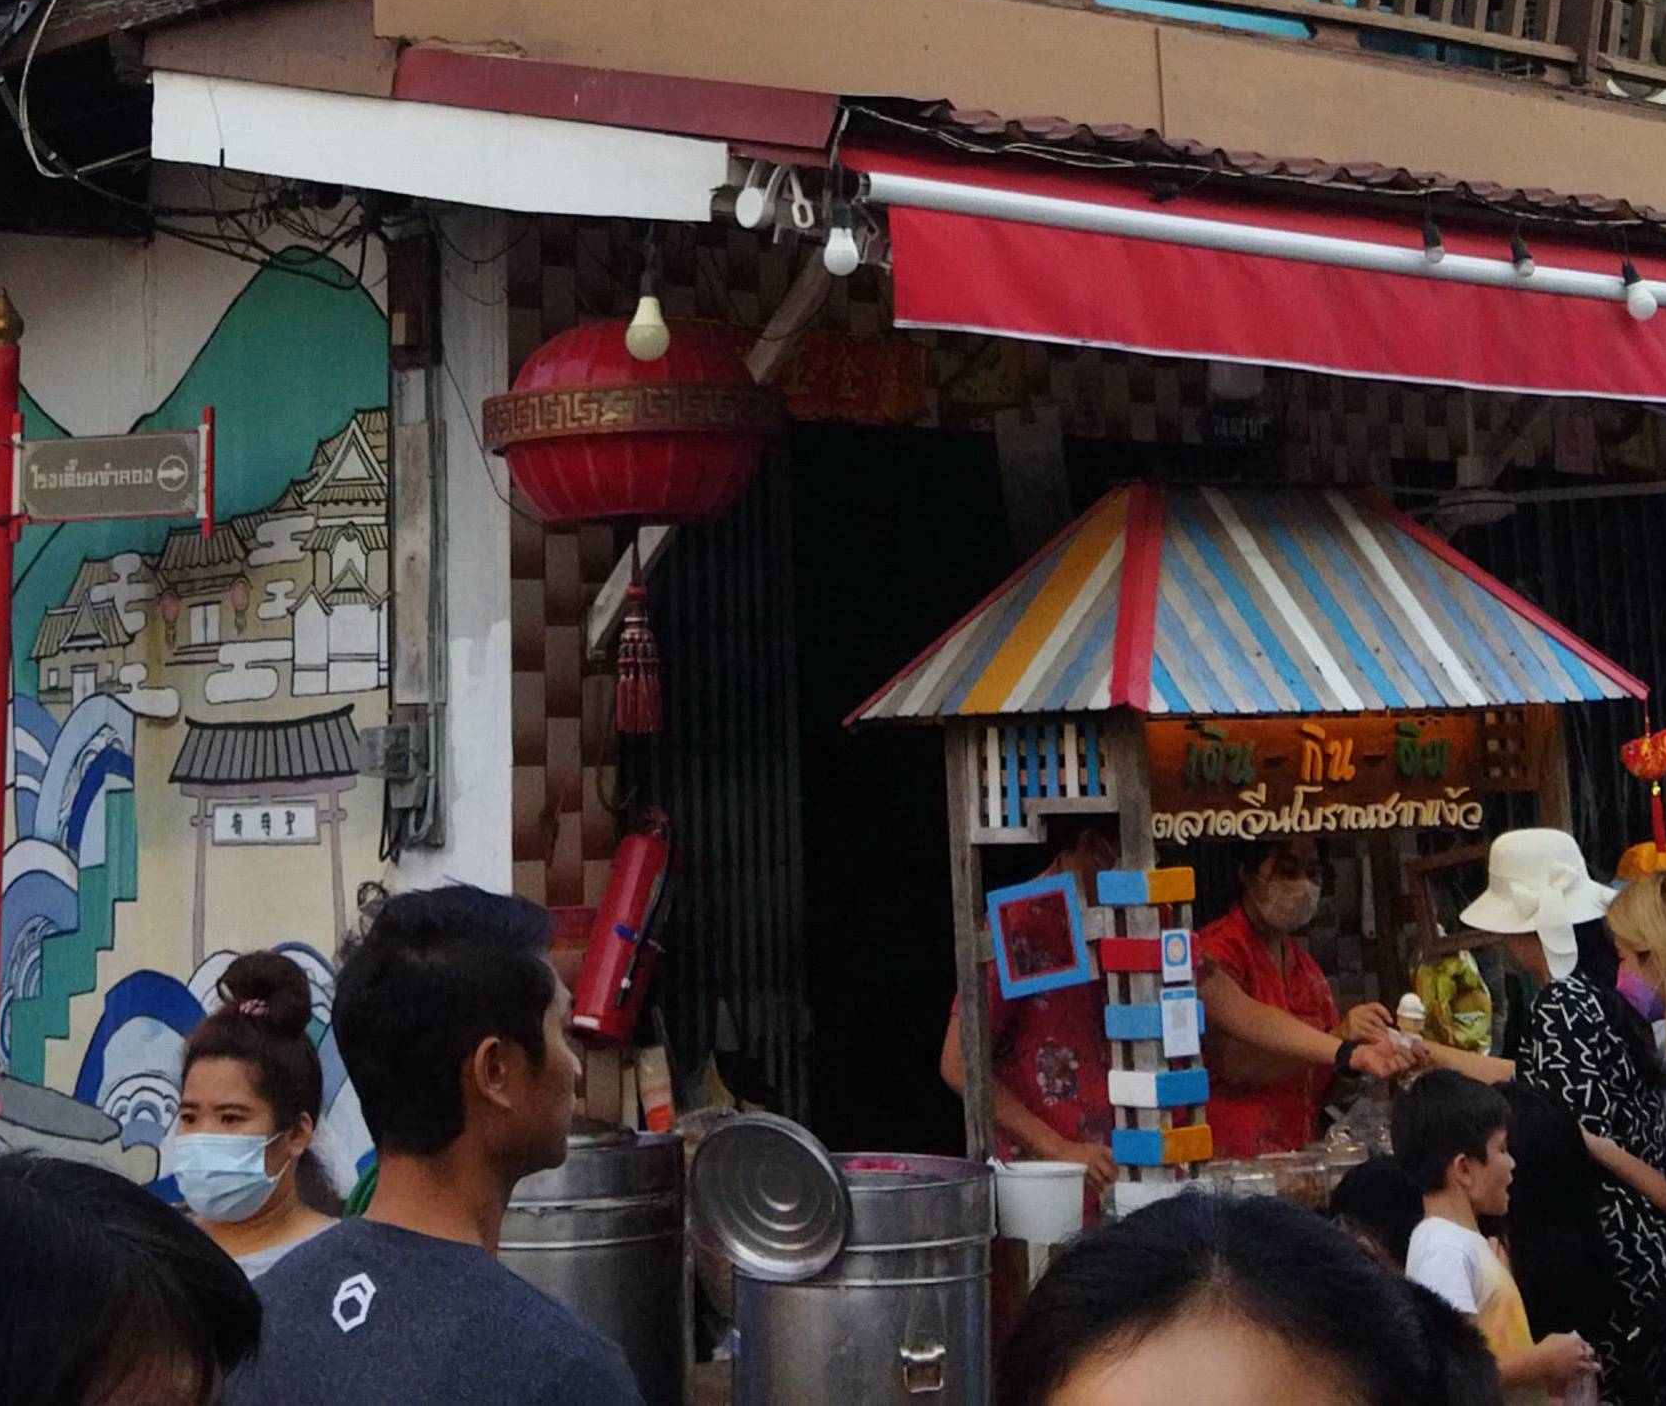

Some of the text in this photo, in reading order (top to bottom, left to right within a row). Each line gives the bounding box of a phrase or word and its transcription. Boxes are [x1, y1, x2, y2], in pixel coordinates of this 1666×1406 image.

[1301, 722, 1357, 781] กิน
[1152, 783, 1484, 846] ตลาดจีนโบราณชากแง้ว
